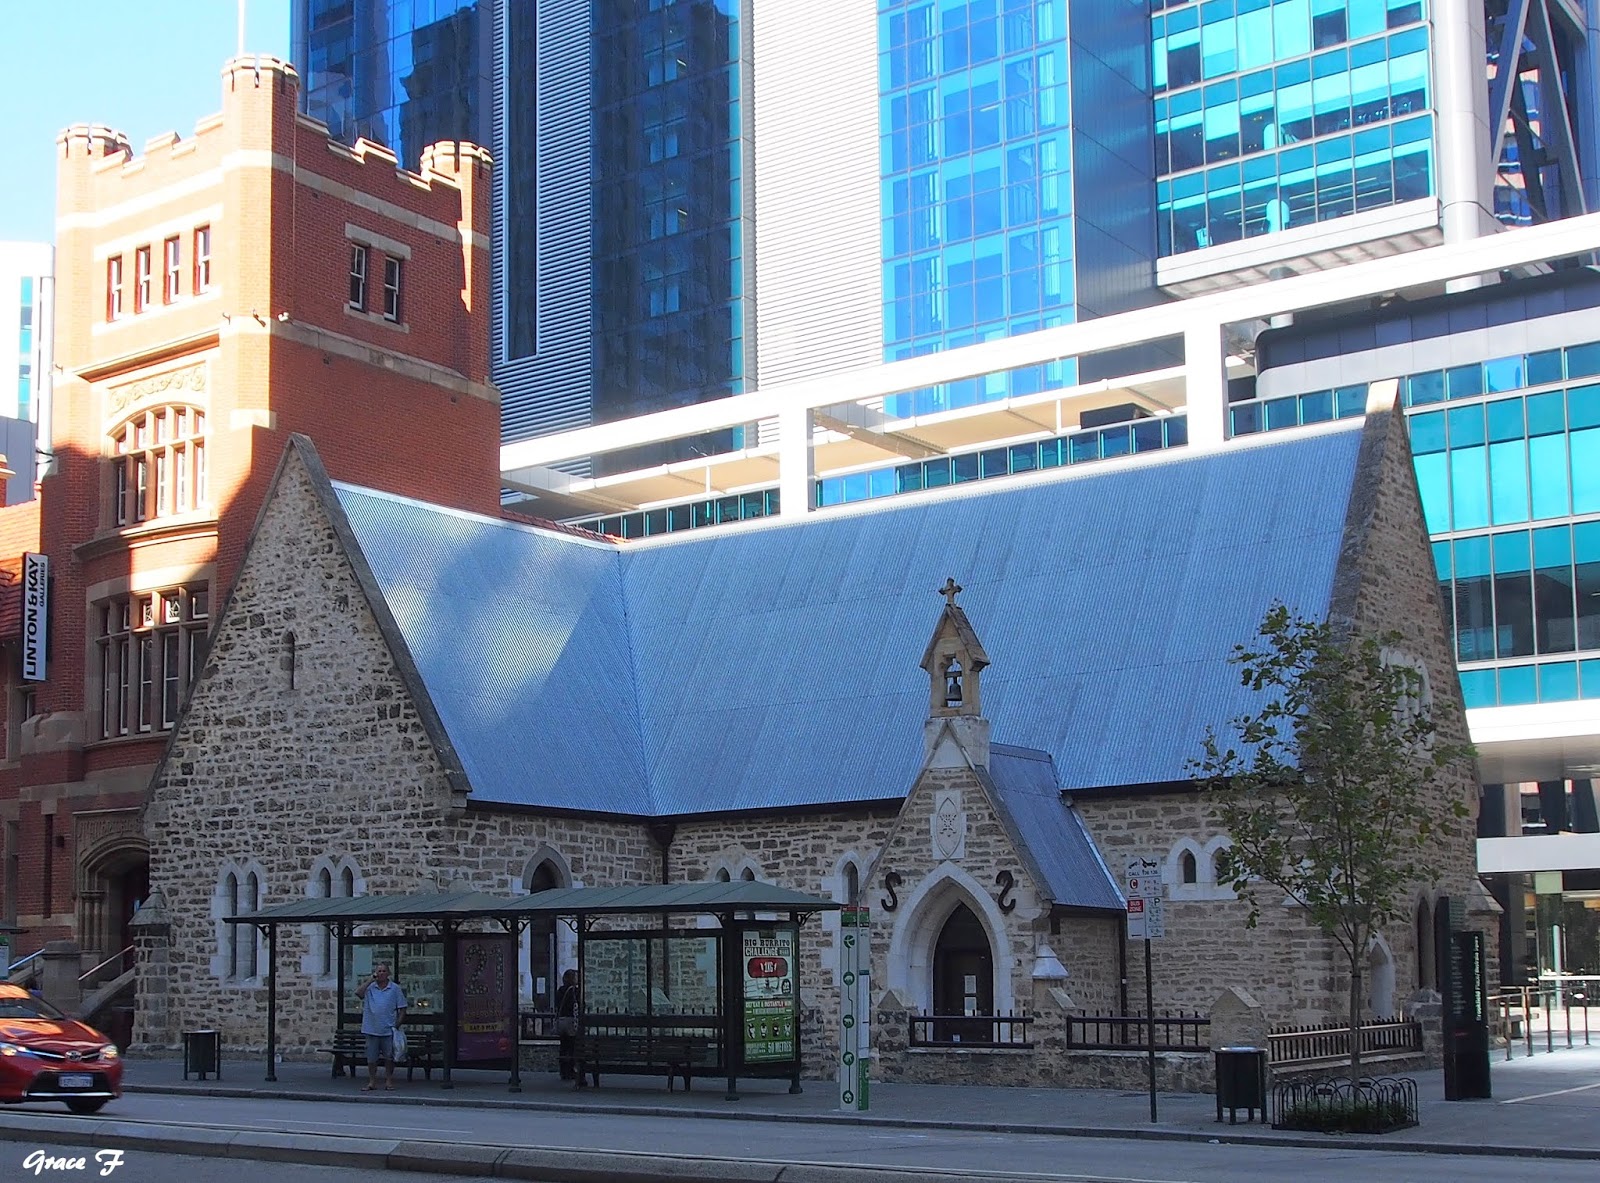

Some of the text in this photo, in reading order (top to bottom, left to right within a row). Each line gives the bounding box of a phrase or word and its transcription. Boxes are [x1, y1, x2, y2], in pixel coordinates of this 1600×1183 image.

[26, 557, 38, 676] LINTON & KAY
[760, 939, 790, 947] BURRITO
[745, 947, 778, 956] CHALLENGE
[464, 944, 504, 994] 21
[486, 1023, 498, 1031] MAY
